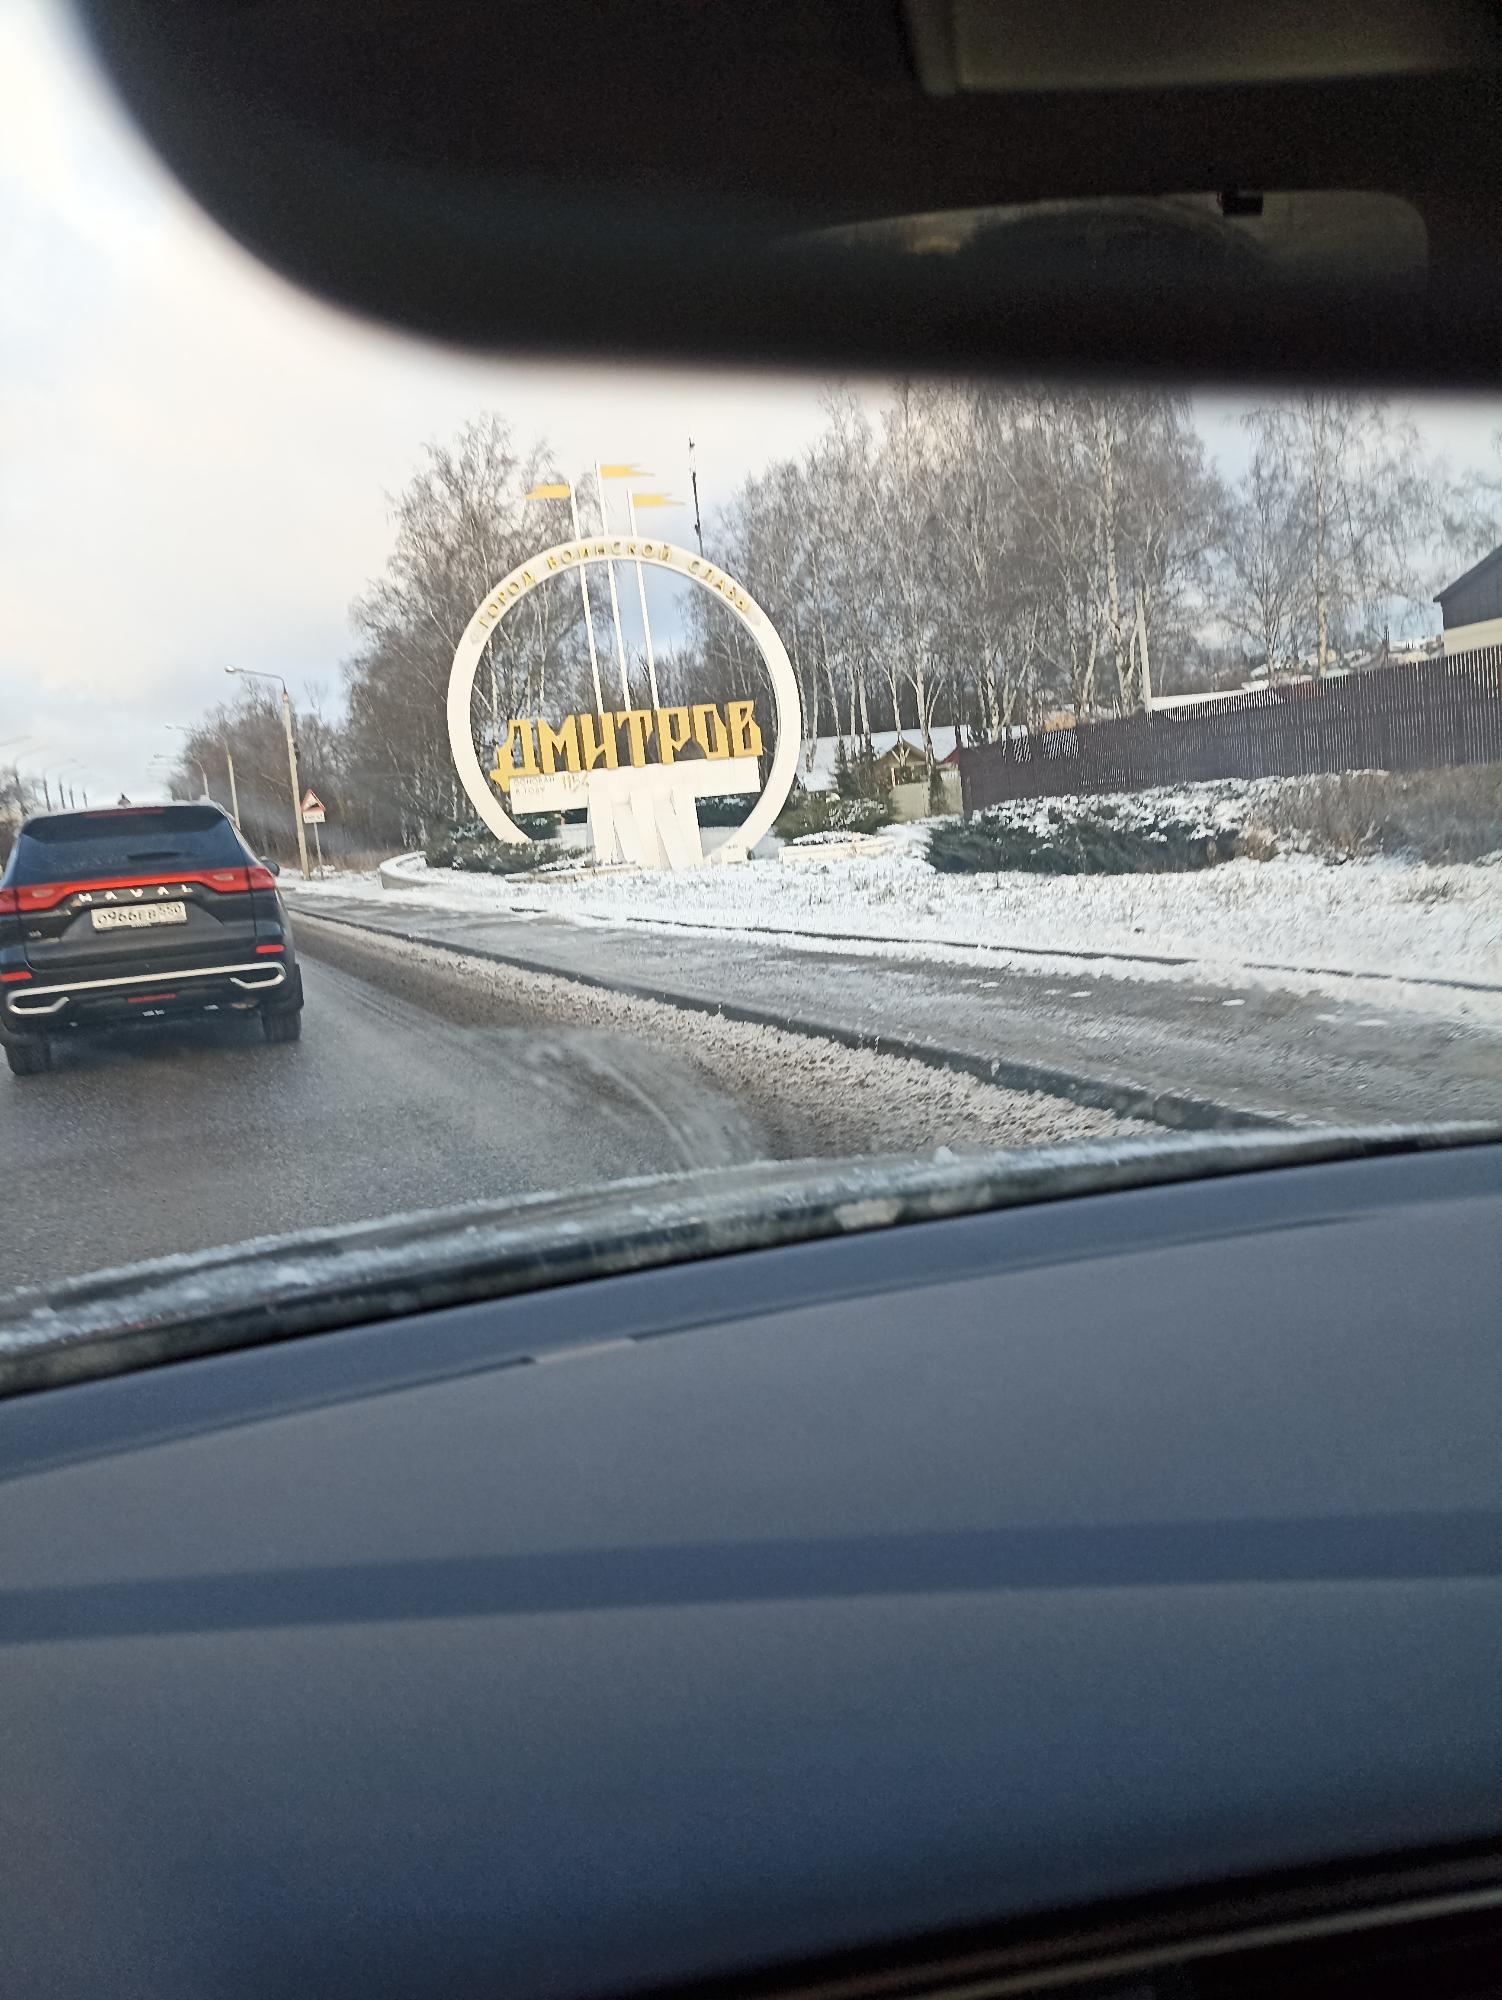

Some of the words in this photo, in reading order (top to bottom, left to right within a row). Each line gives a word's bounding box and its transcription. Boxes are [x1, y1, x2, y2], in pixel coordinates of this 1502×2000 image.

[478, 570, 536, 629] ГОРОД
[546, 541, 672, 570] ВОИНСКОЙ
[688, 559, 749, 612] СЛАВЫ
[489, 699, 763, 793] ДМИТРОВ
[78, 884, 194, 902] HAVAL
